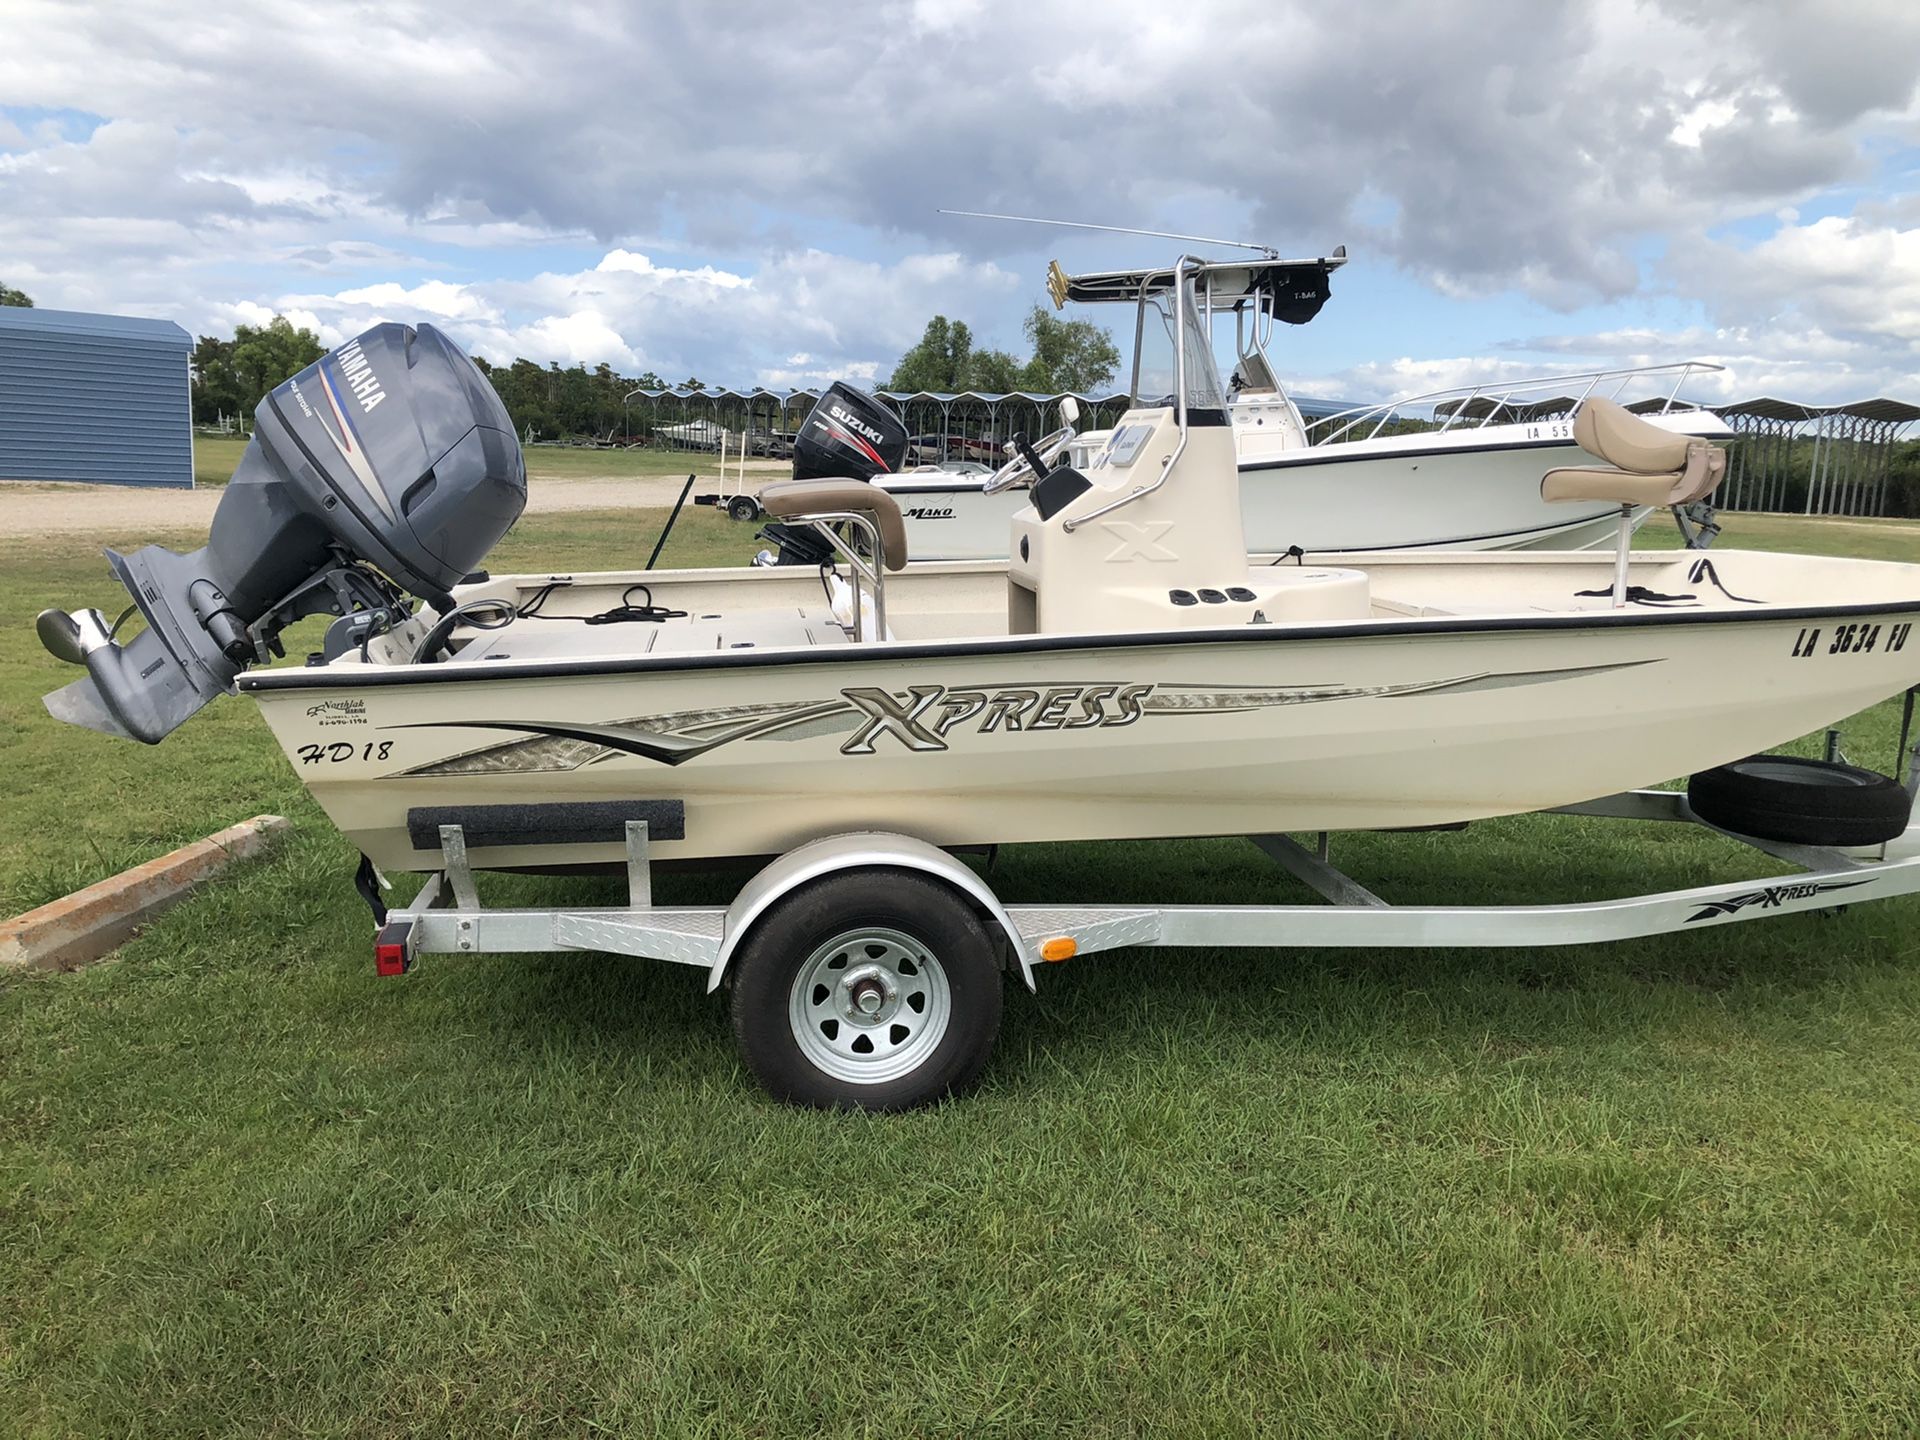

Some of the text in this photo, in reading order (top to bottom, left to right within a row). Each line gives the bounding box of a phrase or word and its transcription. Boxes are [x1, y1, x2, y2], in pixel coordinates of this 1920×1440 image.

[1294, 291, 1316, 300] T-BAG
[336, 338, 387, 413] YAMAHA
[829, 405, 884, 445] SUZUKI
[1527, 427, 1540, 439] LA
[902, 507, 956, 520] MAKO
[1791, 623, 1912, 657] LA 3634 FU
[839, 684, 1154, 755] XPRESS
[297, 741, 394, 765] HD 18
[1761, 884, 1819, 909] XPRESS
